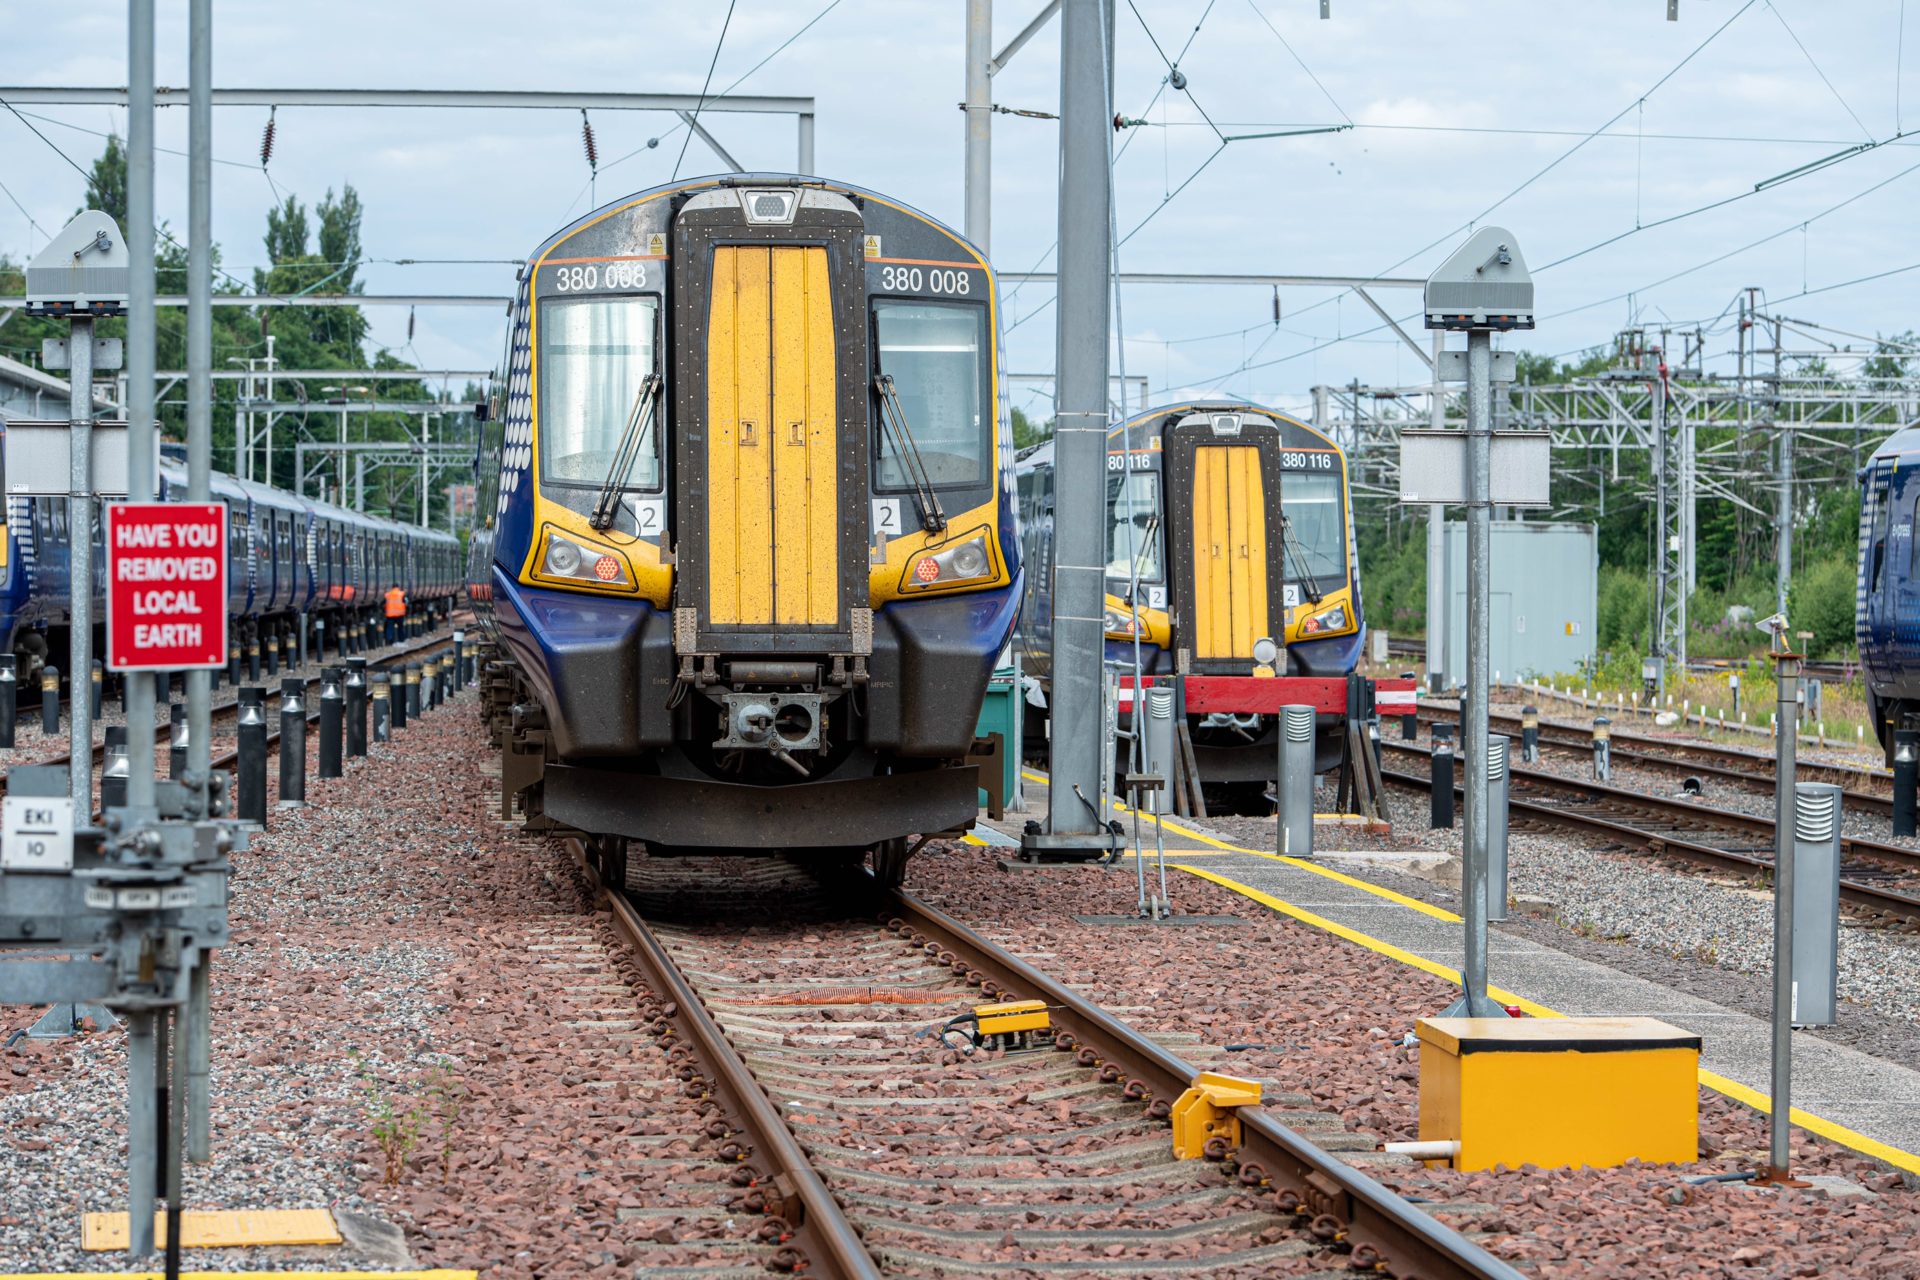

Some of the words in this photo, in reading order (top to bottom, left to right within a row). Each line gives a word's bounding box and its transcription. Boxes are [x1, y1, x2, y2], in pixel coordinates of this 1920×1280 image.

[557, 266, 598, 291] 380
[605, 264, 646, 289] 008
[882, 266, 923, 292] 380
[930, 269, 970, 295] 008
[1108, 455, 1124, 470] 80
[1129, 453, 1150, 469] 116
[1282, 452, 1306, 468] 380
[1309, 453, 1331, 469] 116
[642, 506, 657, 528] 2
[880, 505, 894, 527] 2
[116, 523, 172, 548] HAVE
[174, 523, 218, 548] YOU
[117, 557, 218, 582] REMOVED
[133, 590, 203, 615] LOCAL
[1153, 591, 1161, 604] 2
[1287, 589, 1295, 601] 2
[134, 623, 202, 649] EARTH
